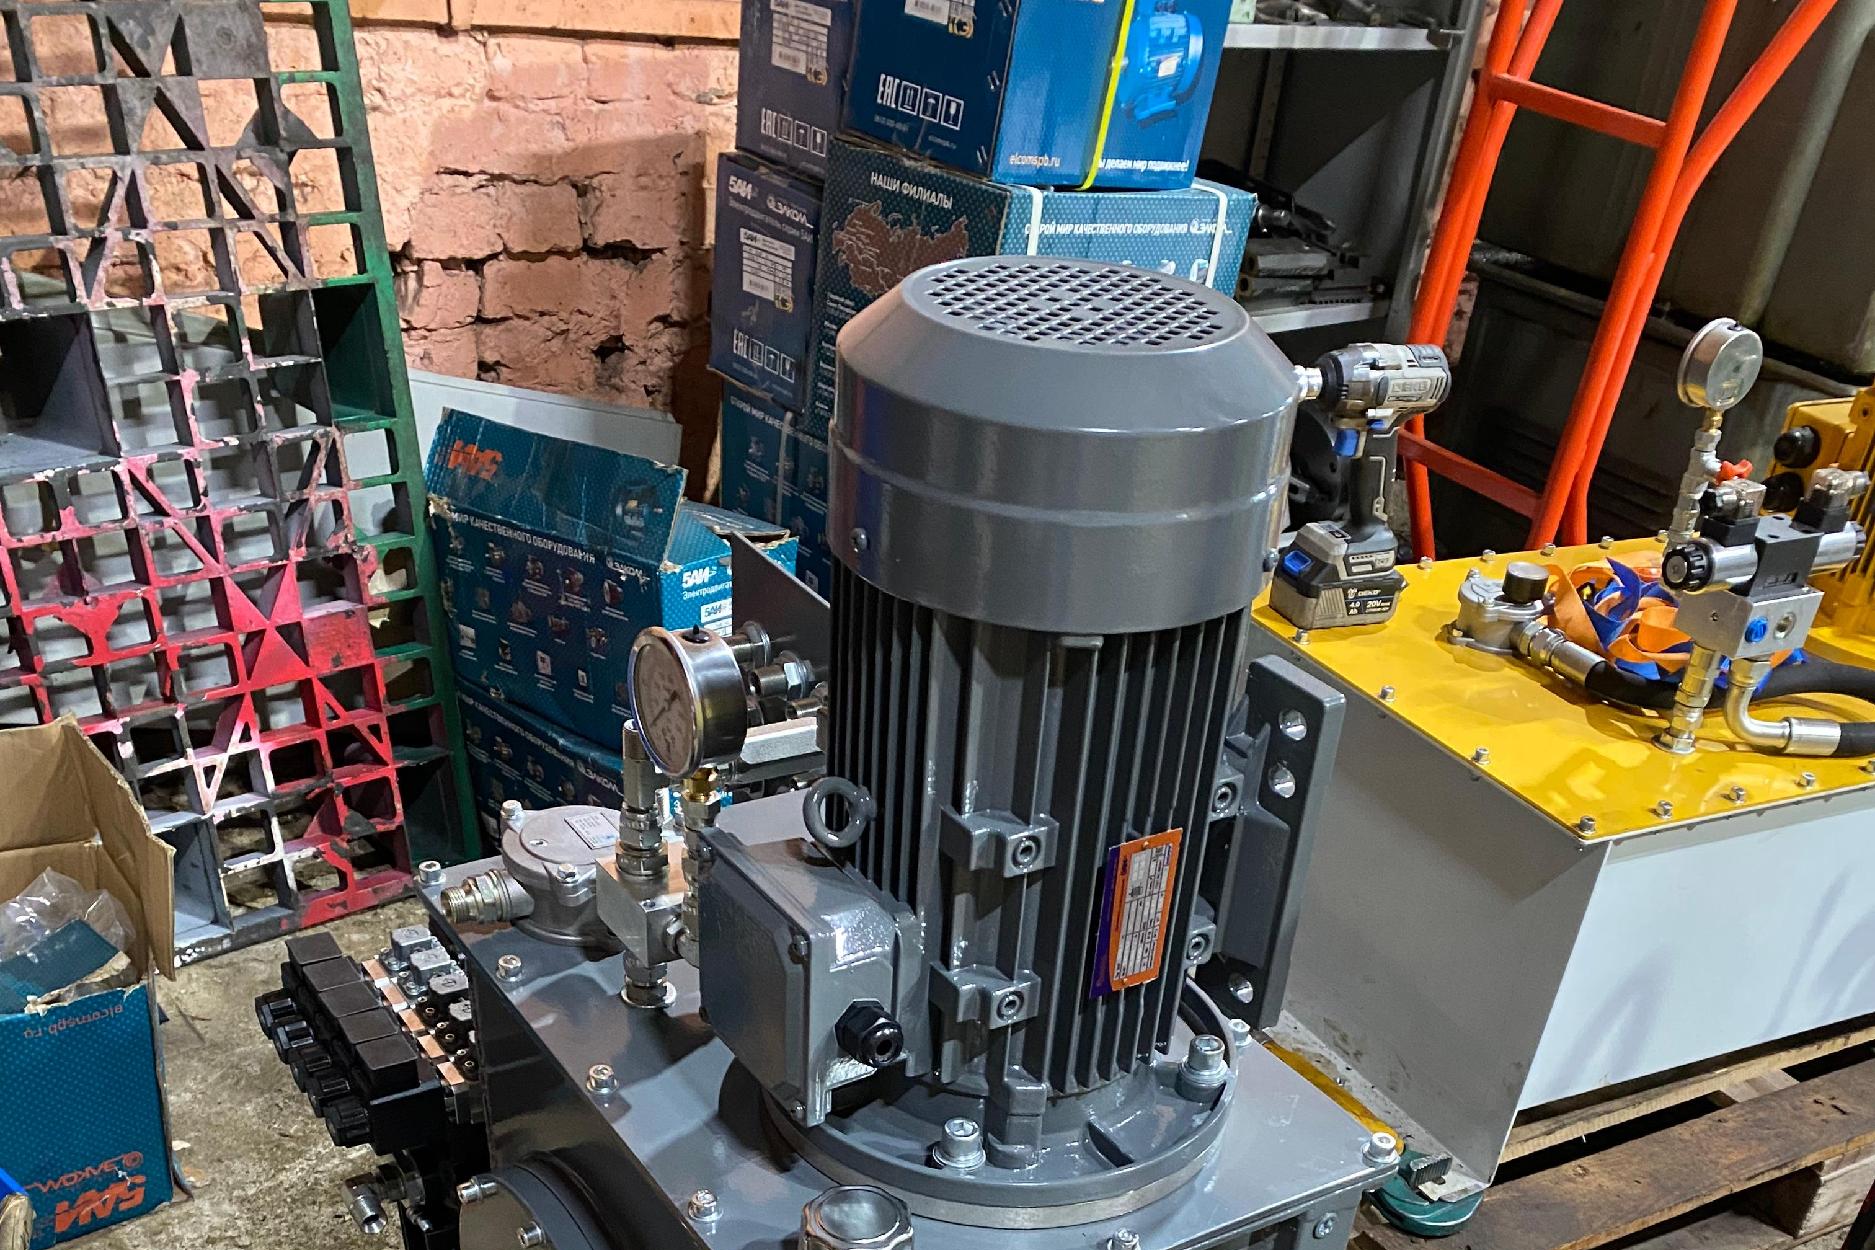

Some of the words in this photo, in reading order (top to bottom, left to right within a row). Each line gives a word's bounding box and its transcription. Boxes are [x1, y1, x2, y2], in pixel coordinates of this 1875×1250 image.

[870, 171, 901, 193] НАШИ
[901, 181, 953, 210] ФИЛИАЛЫ
[1056, 222, 1074, 235] МИР
[1073, 222, 1133, 236] КАЧЕСТВЕННОГО
[1132, 222, 1188, 236] ОБОРУДОВАНИЯ
[469, 516, 532, 545] КАЧЕСТВЕННОГО
[532, 532, 597, 565] ОБОРУДОВАНИЯ
